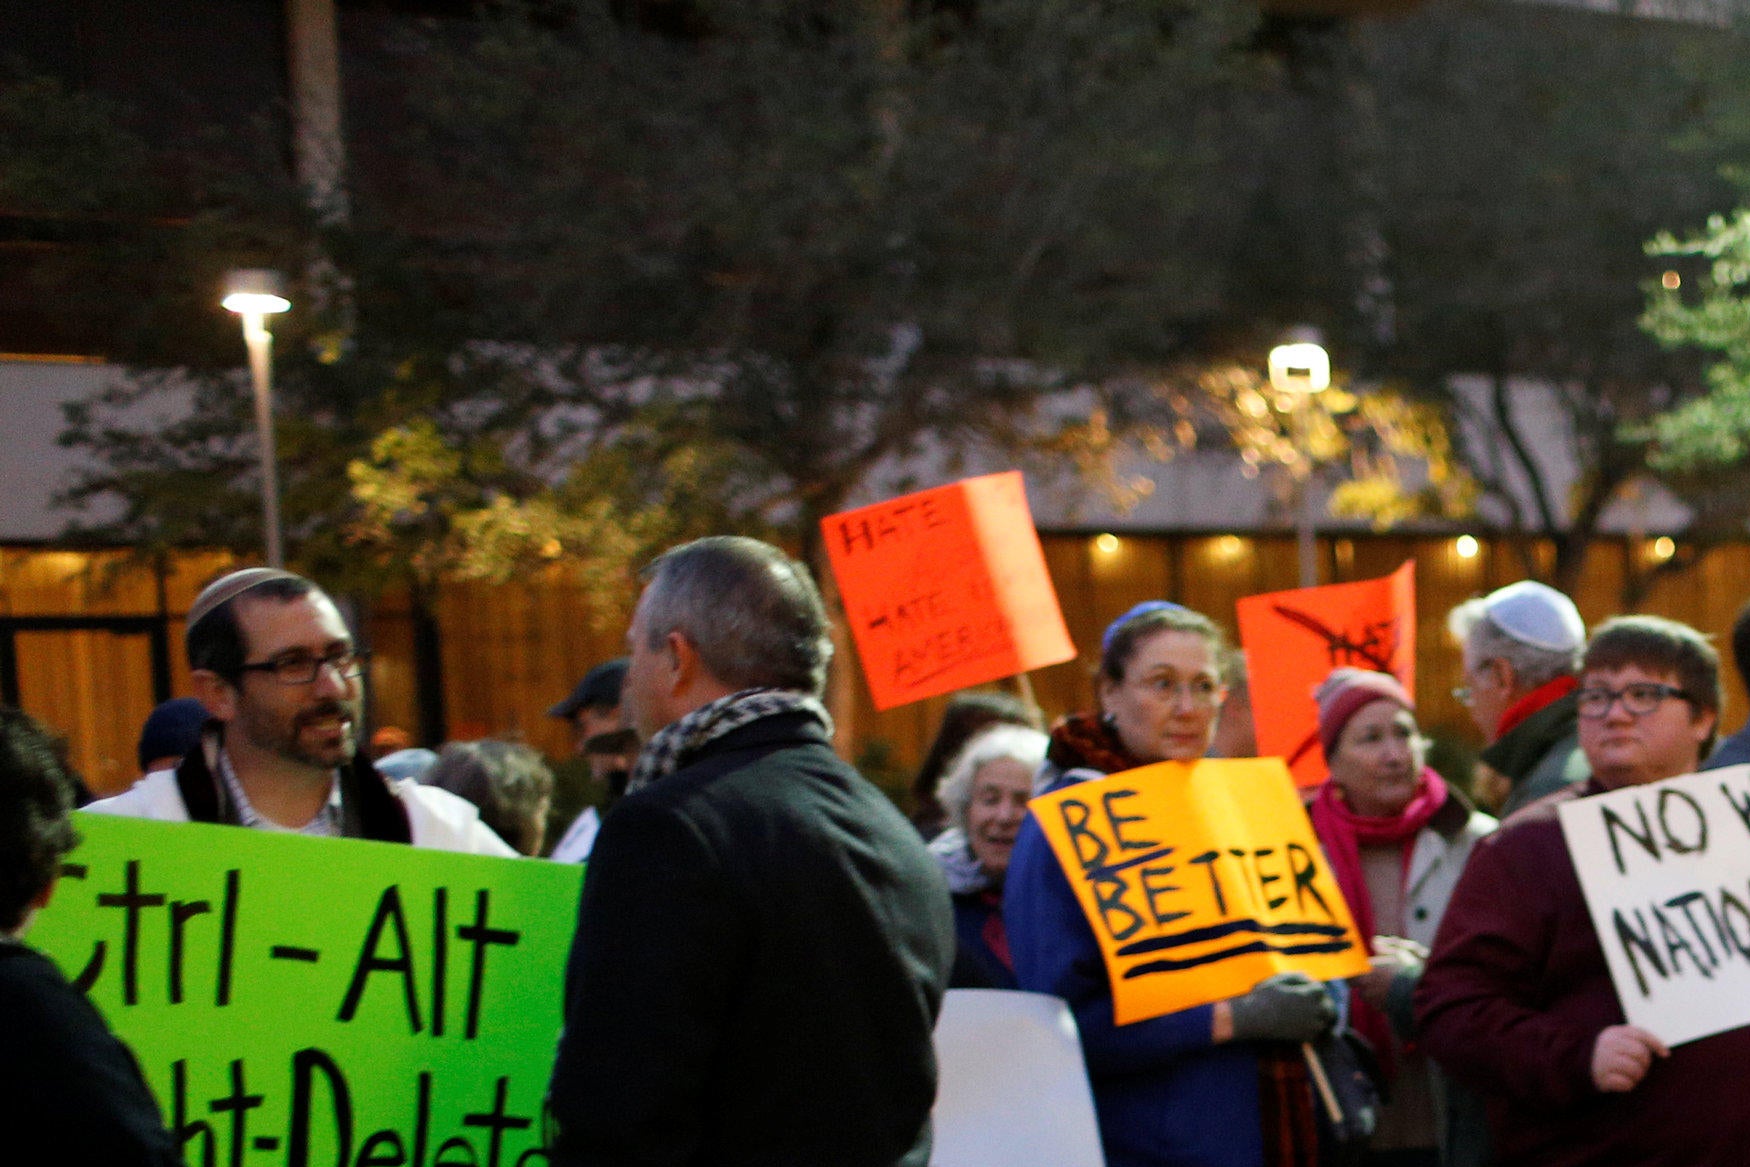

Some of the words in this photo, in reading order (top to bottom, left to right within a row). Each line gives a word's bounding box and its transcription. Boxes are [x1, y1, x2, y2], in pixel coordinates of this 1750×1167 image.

[839, 500, 946, 554] HATE
[1060, 790, 1161, 870] BE
[1600, 788, 1709, 876] NO
[1096, 843, 1338, 941] BETTER
